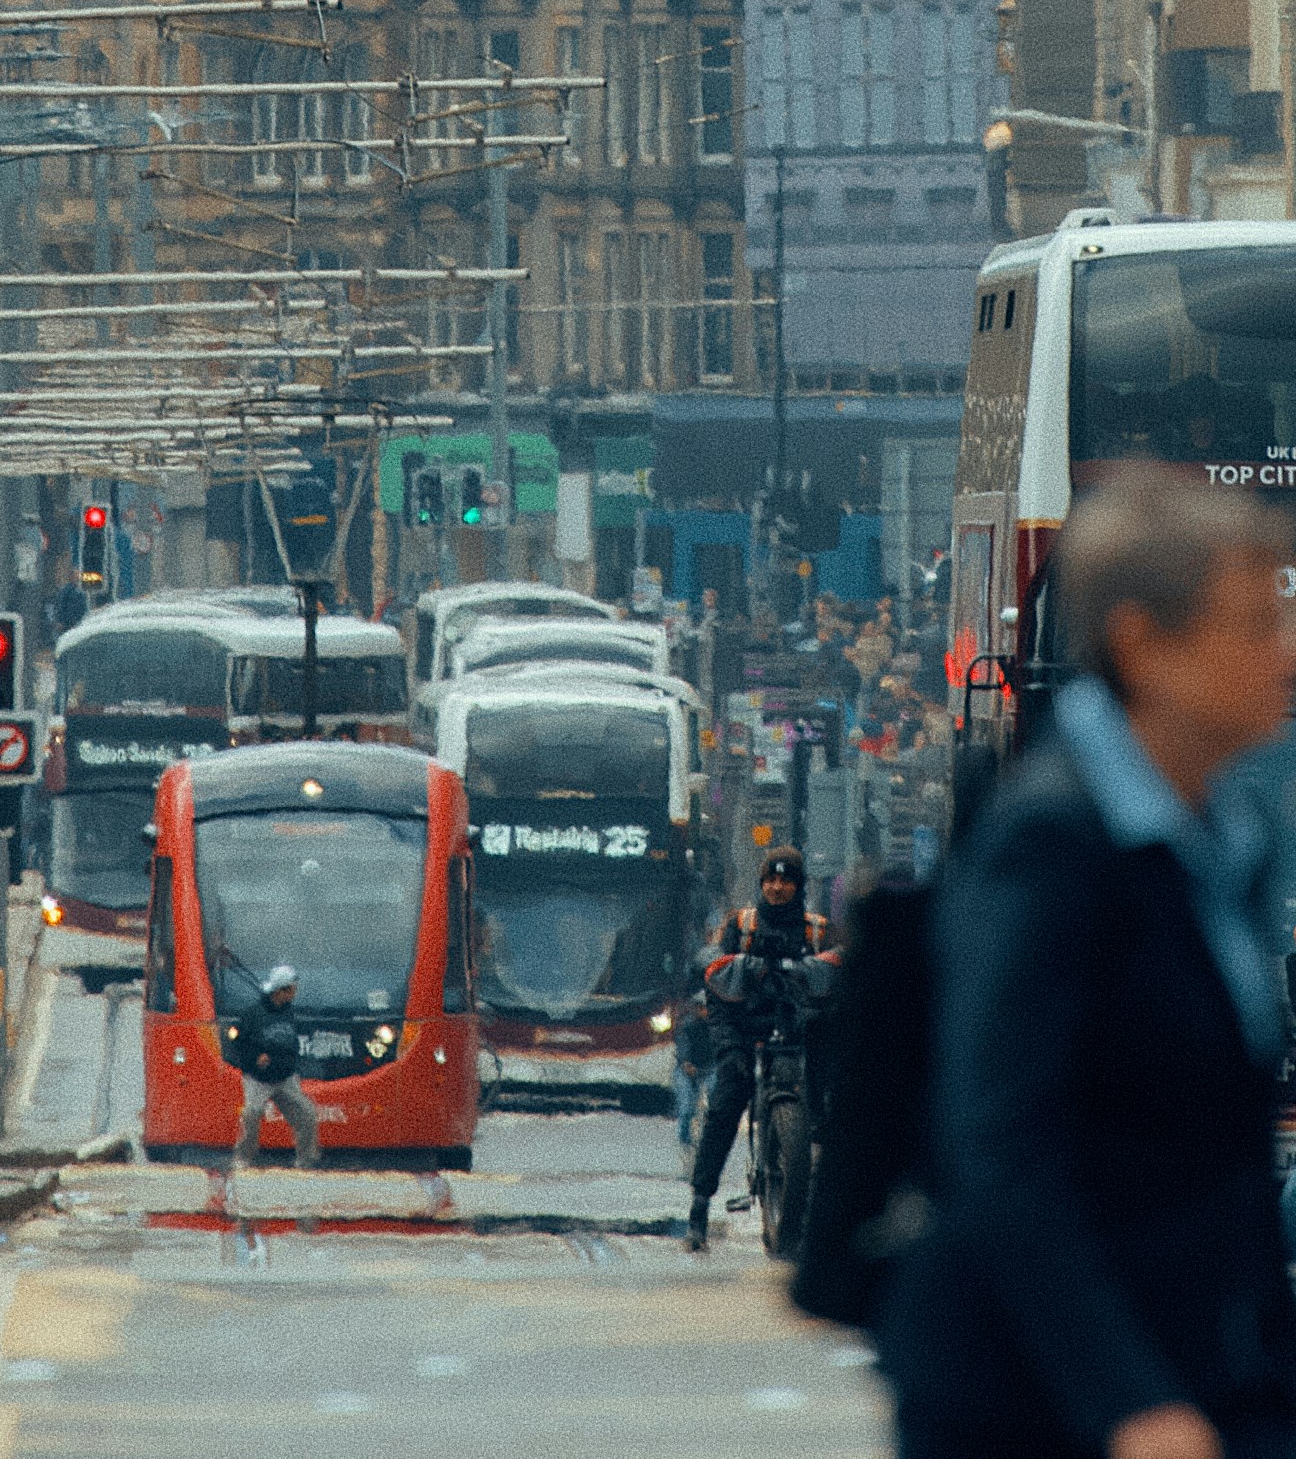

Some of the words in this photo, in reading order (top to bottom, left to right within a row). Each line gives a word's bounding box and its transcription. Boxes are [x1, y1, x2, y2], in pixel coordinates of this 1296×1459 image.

[1266, 445, 1290, 460] UK
[1205, 464, 1253, 485] TOP
[603, 824, 650, 858] 25
